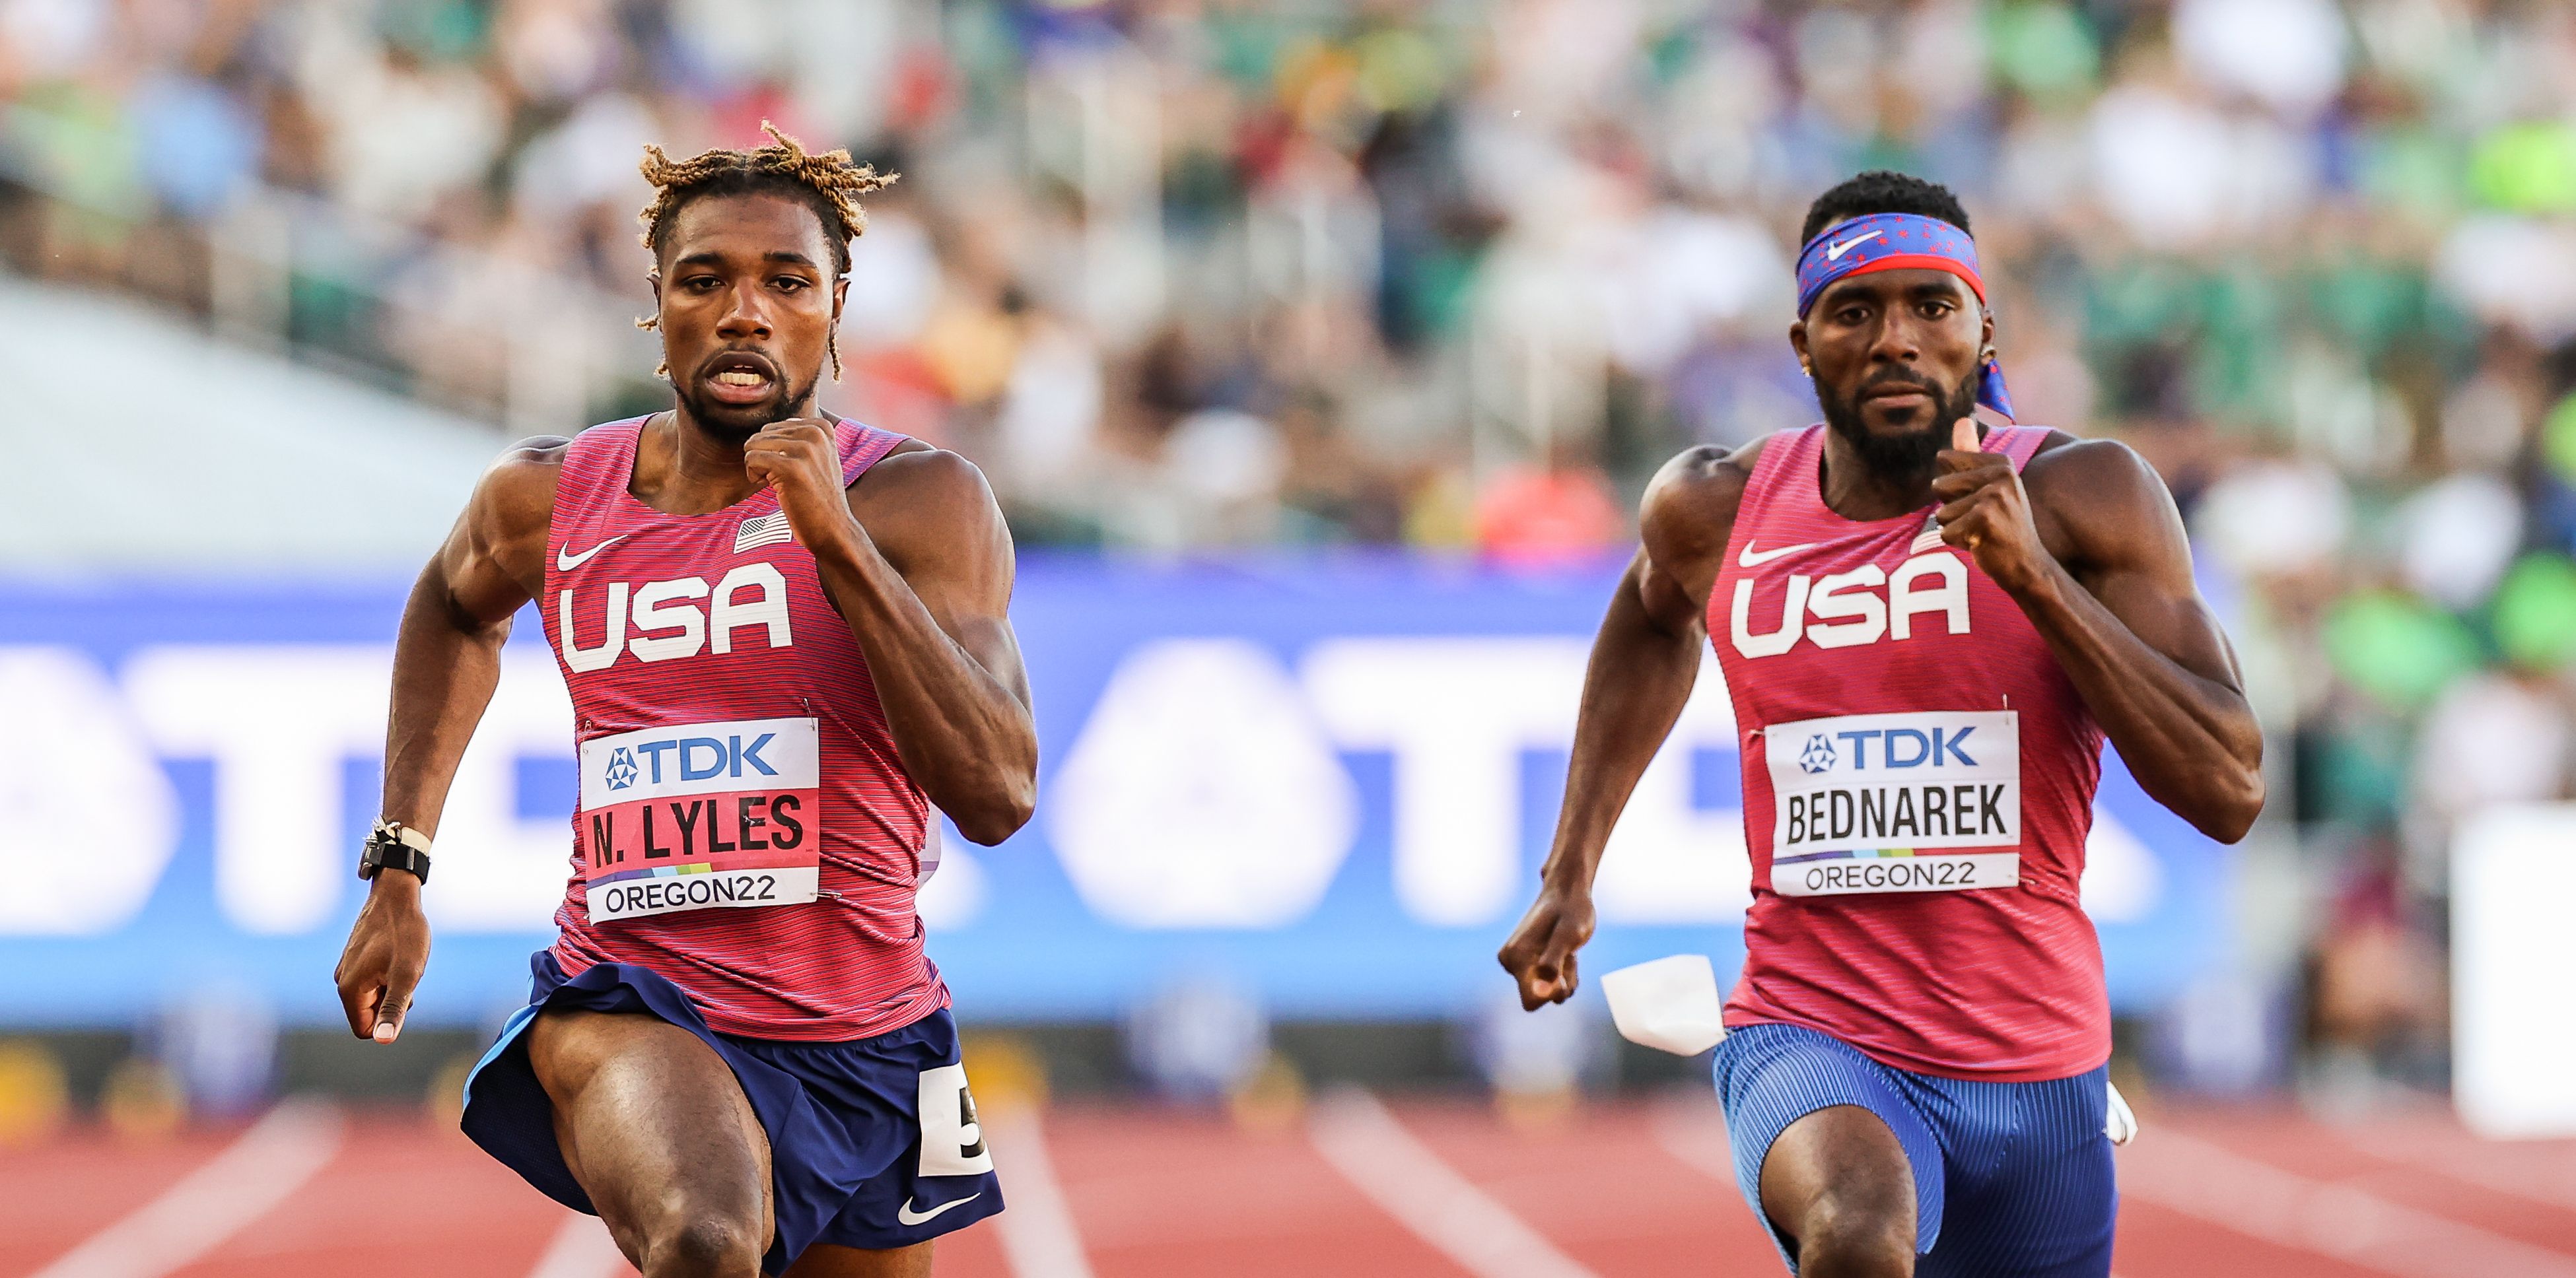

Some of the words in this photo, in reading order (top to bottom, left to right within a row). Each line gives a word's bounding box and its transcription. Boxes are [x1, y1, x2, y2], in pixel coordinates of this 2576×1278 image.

[559, 561, 793, 674] USA
[1730, 551, 1971, 659] USA
[637, 732, 779, 784] TDK
[1837, 726, 1979, 770] TDK
[592, 811, 625, 869] N.
[643, 794, 804, 859] LYLES
[1787, 784, 2007, 845] BEDNAREK
[605, 875, 777, 914] OREGON22
[1805, 861, 1976, 891] OREGON22
